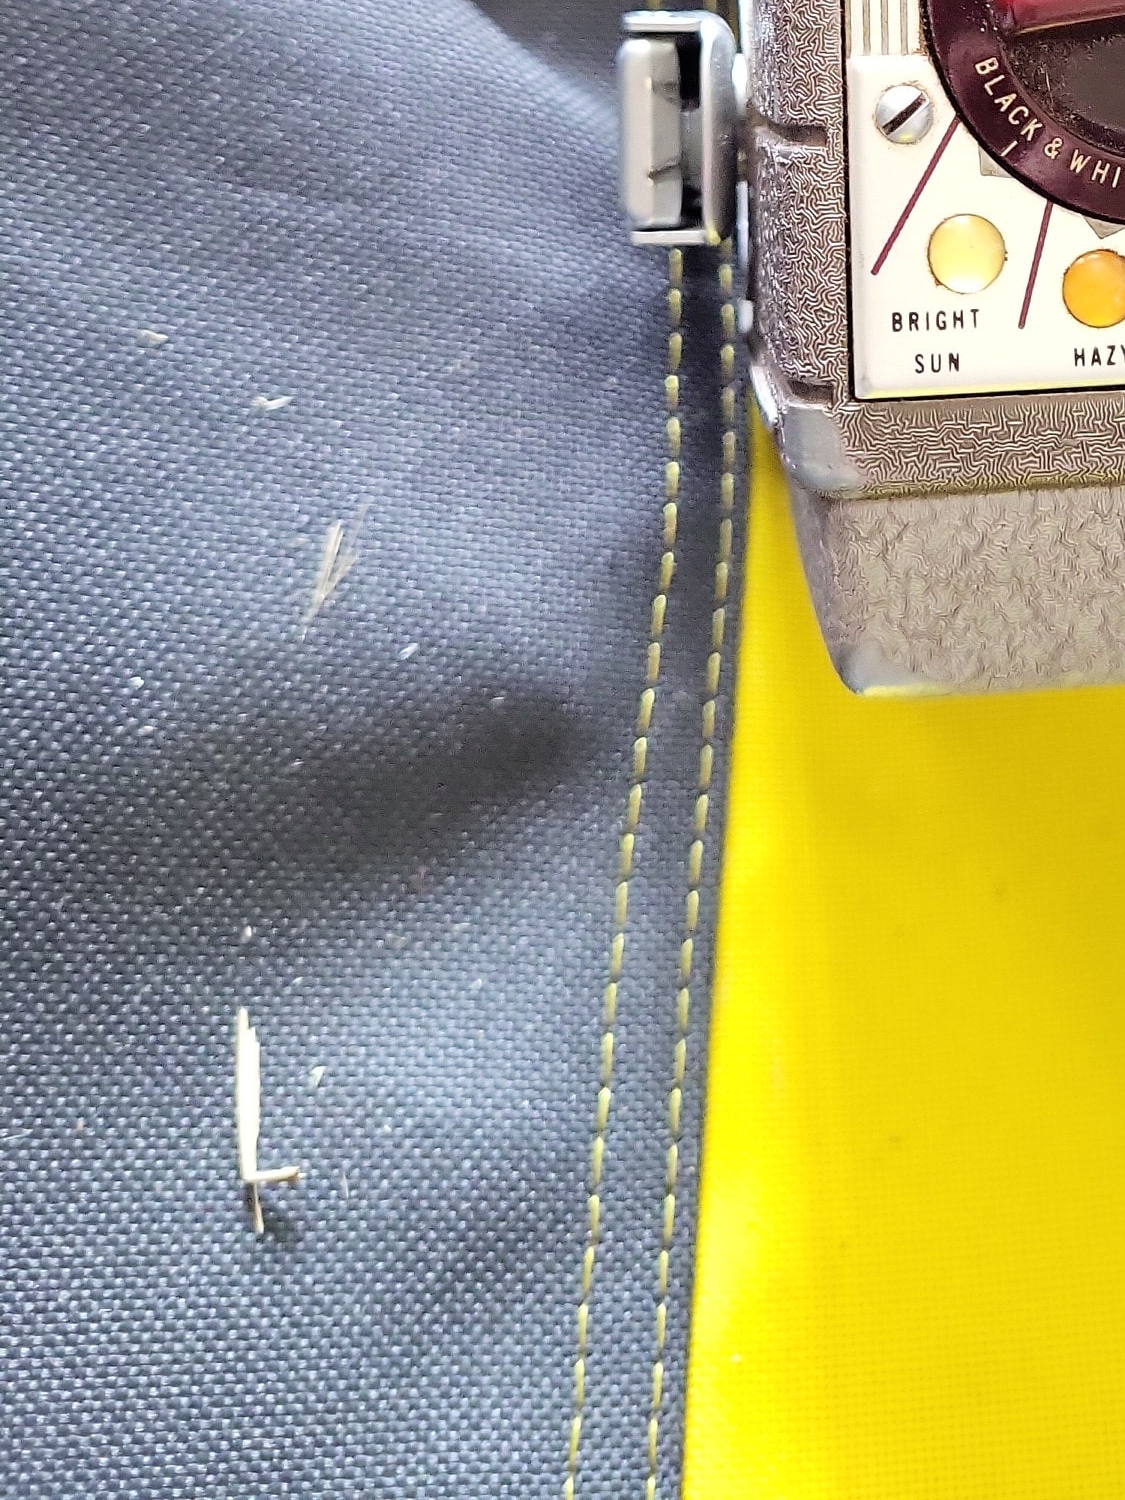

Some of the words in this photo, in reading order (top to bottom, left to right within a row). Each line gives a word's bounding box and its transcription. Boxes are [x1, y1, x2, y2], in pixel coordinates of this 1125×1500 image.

[974, 56, 1044, 142] BLACK
[1044, 137, 1063, 160] &
[891, 308, 980, 333] BRIGHT
[914, 352, 960, 374] SUN
